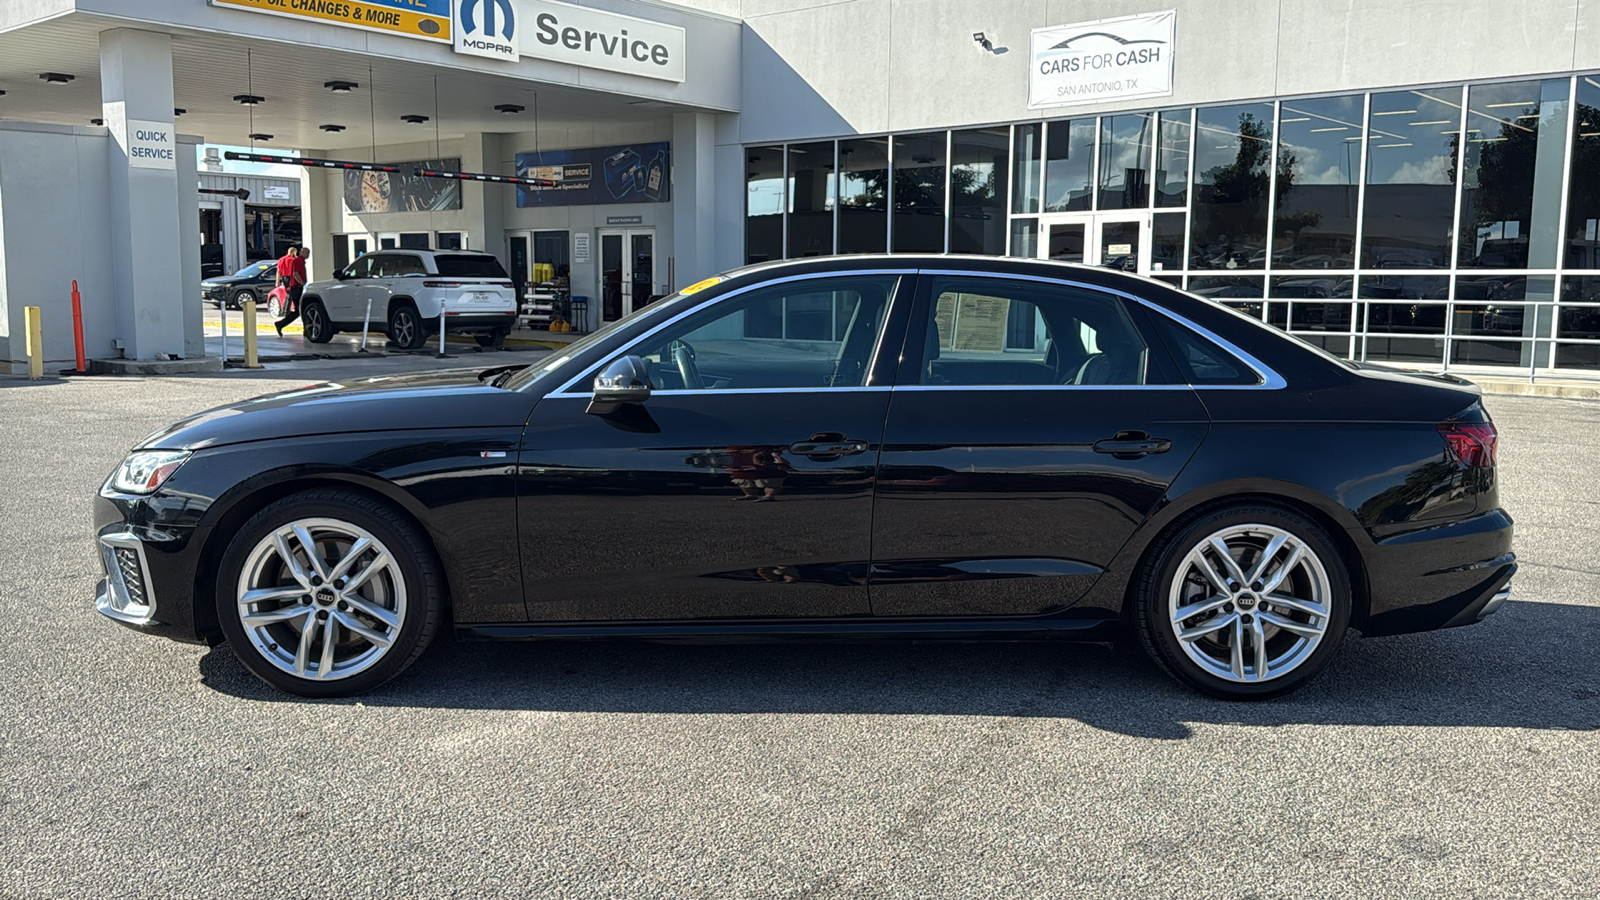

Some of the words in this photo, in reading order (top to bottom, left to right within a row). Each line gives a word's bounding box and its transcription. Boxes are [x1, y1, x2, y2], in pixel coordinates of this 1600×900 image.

[291, 0, 350, 17] CHANGES
[352, 7, 362, 20] &
[365, 9, 401, 26] MORE
[463, 38, 513, 55] MOPAR
[536, 13, 669, 66] Service
[1040, 57, 1080, 75] CARS
[1083, 53, 1113, 71] FOR
[1115, 47, 1160, 67] CASH
[1057, 86, 1077, 97] SAN
[1078, 80, 1123, 95] ANTONIO,
[1126, 79, 1138, 89] TX
[136, 130, 167, 142] QUICK
[131, 146, 173, 160] SERVICE
[564, 168, 589, 177] SERVICE
